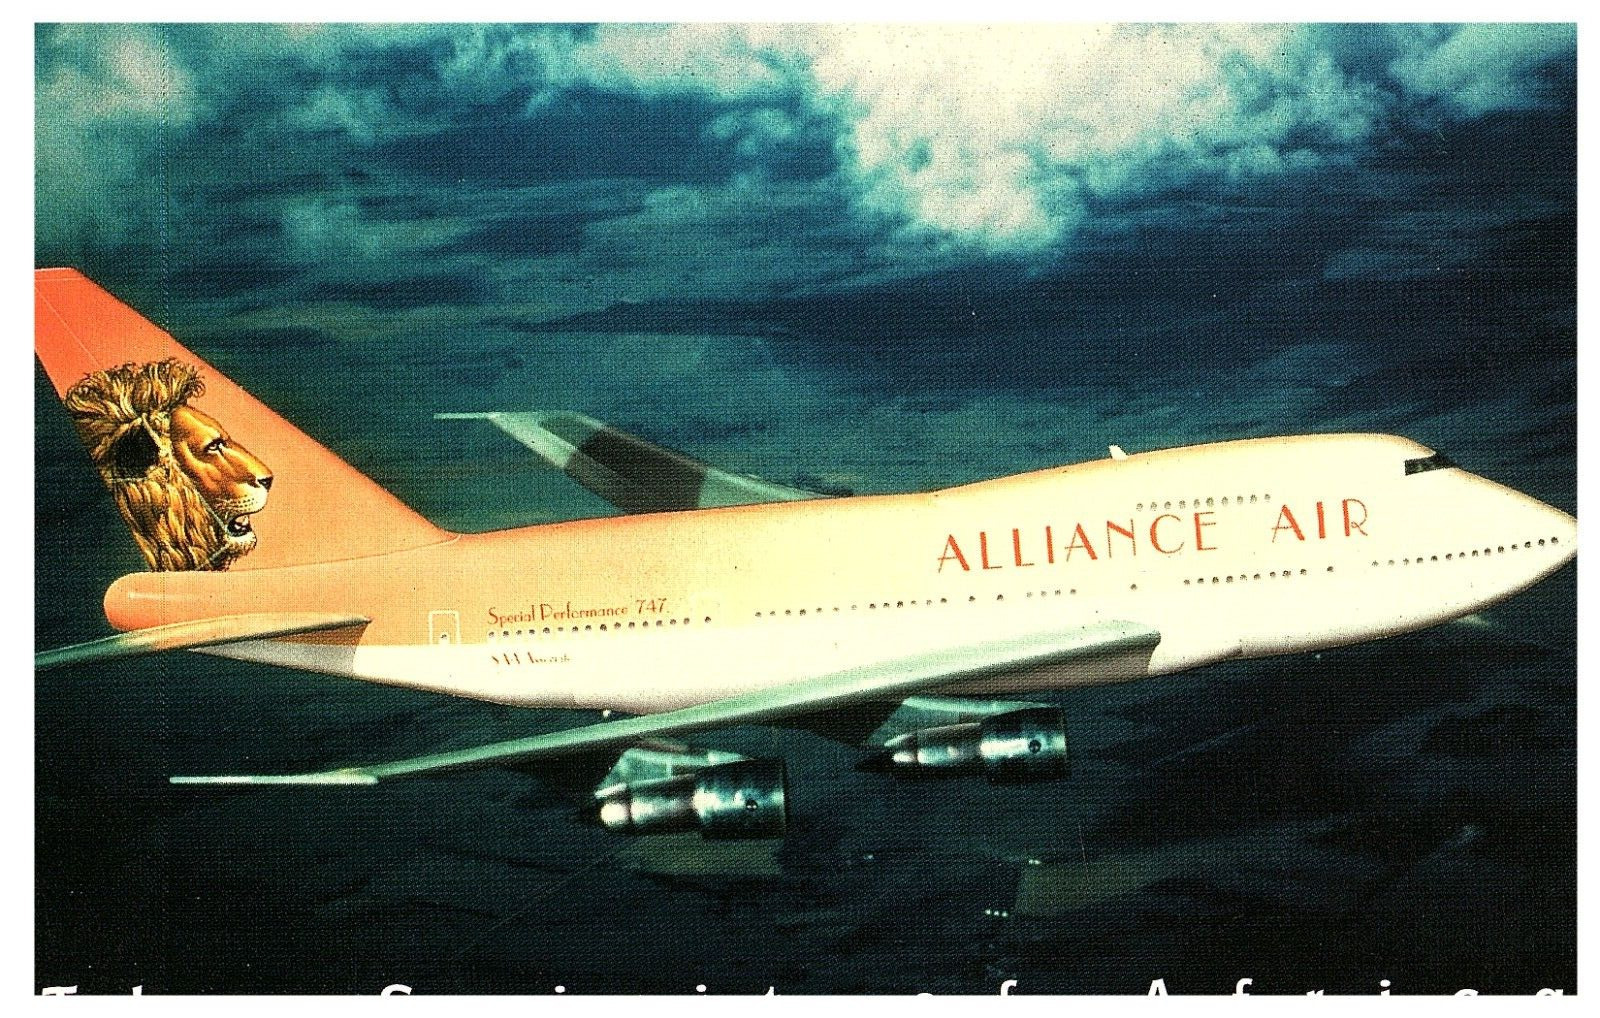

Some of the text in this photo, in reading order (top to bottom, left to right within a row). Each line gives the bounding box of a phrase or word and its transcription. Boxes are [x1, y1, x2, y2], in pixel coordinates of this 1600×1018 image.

[938, 499, 1369, 573] ALLIANCE AIR
[487, 604, 535, 628] Special
[540, 600, 628, 621] Performance
